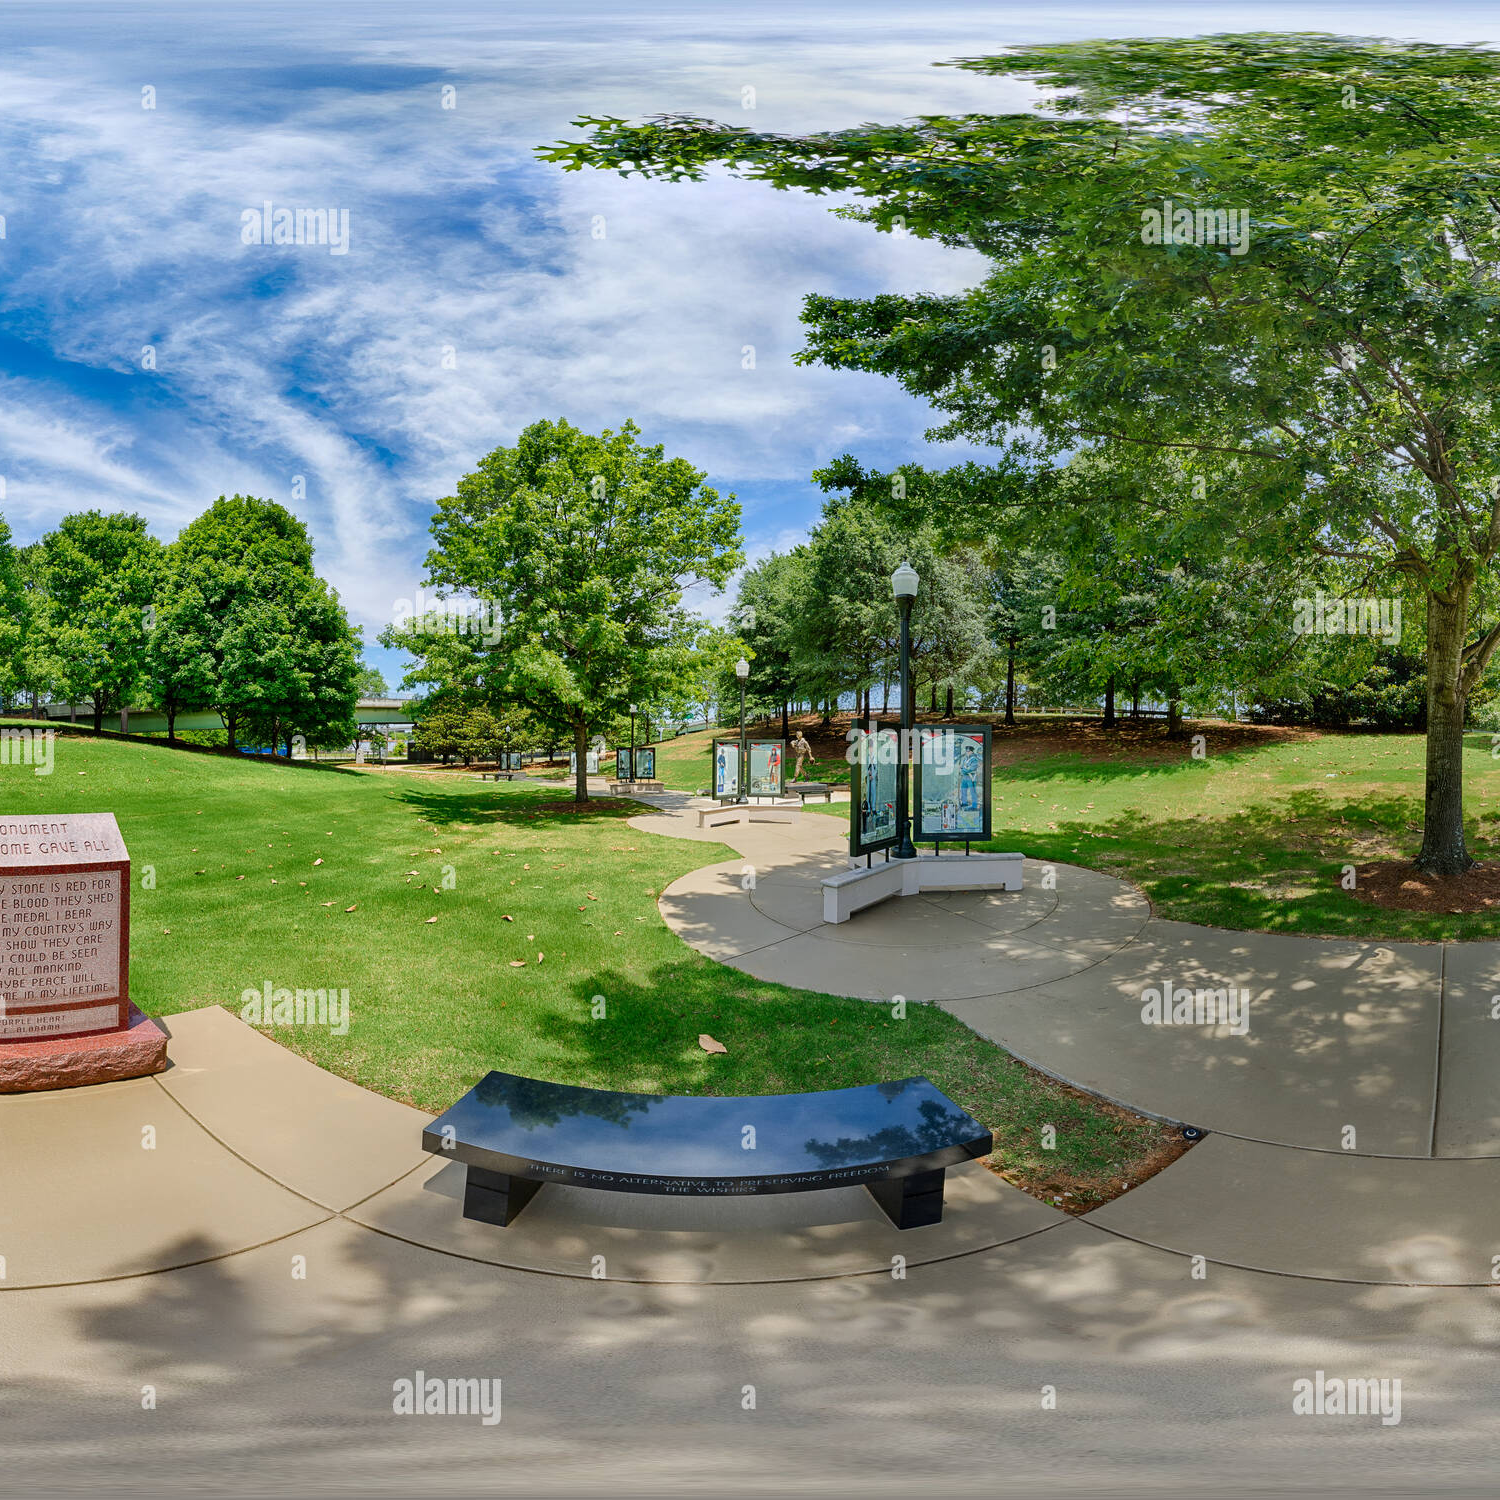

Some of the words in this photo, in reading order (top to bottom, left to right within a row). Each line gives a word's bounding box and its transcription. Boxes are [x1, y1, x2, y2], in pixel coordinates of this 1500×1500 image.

[39, 842, 78, 854] GAVE
[84, 840, 110, 851] ALL
[11, 884, 45, 895] STONE
[51, 882, 60, 893] IS
[66, 881, 86, 892] RED
[92, 879, 111, 889] FOR
[14, 898, 49, 909] BLOOD
[54, 895, 82, 906] THEY
[87, 893, 114, 904] SHED
[14, 912, 50, 923] MEDAL
[65, 908, 92, 920] BEAR
[2, 927, 20, 937] MY
[25, 923, 85, 936] COUNTRY'S
[89, 920, 113, 931] WAY
[6, 940, 37, 951] SHOW
[44, 938, 70, 948] THEY
[76, 934, 102, 946] CARE
[10, 952, 46, 963] COULD
[52, 951, 65, 960] BE
[72, 948, 98, 959] SEEN
[8, 966, 26, 976] ALL
[32, 976, 66, 987] PEACE
[72, 973, 95, 984] WILL
[24, 991, 34, 999] IN
[40, 990, 57, 999] MY
[37, 1015, 66, 1023] HEART
[528, 1164, 564, 1175] THERE
[619, 1176, 709, 1187] ALTERNATIVE
[740, 1175, 822, 1186] PRESERVING
[828, 1165, 891, 1180] FREEDOM
